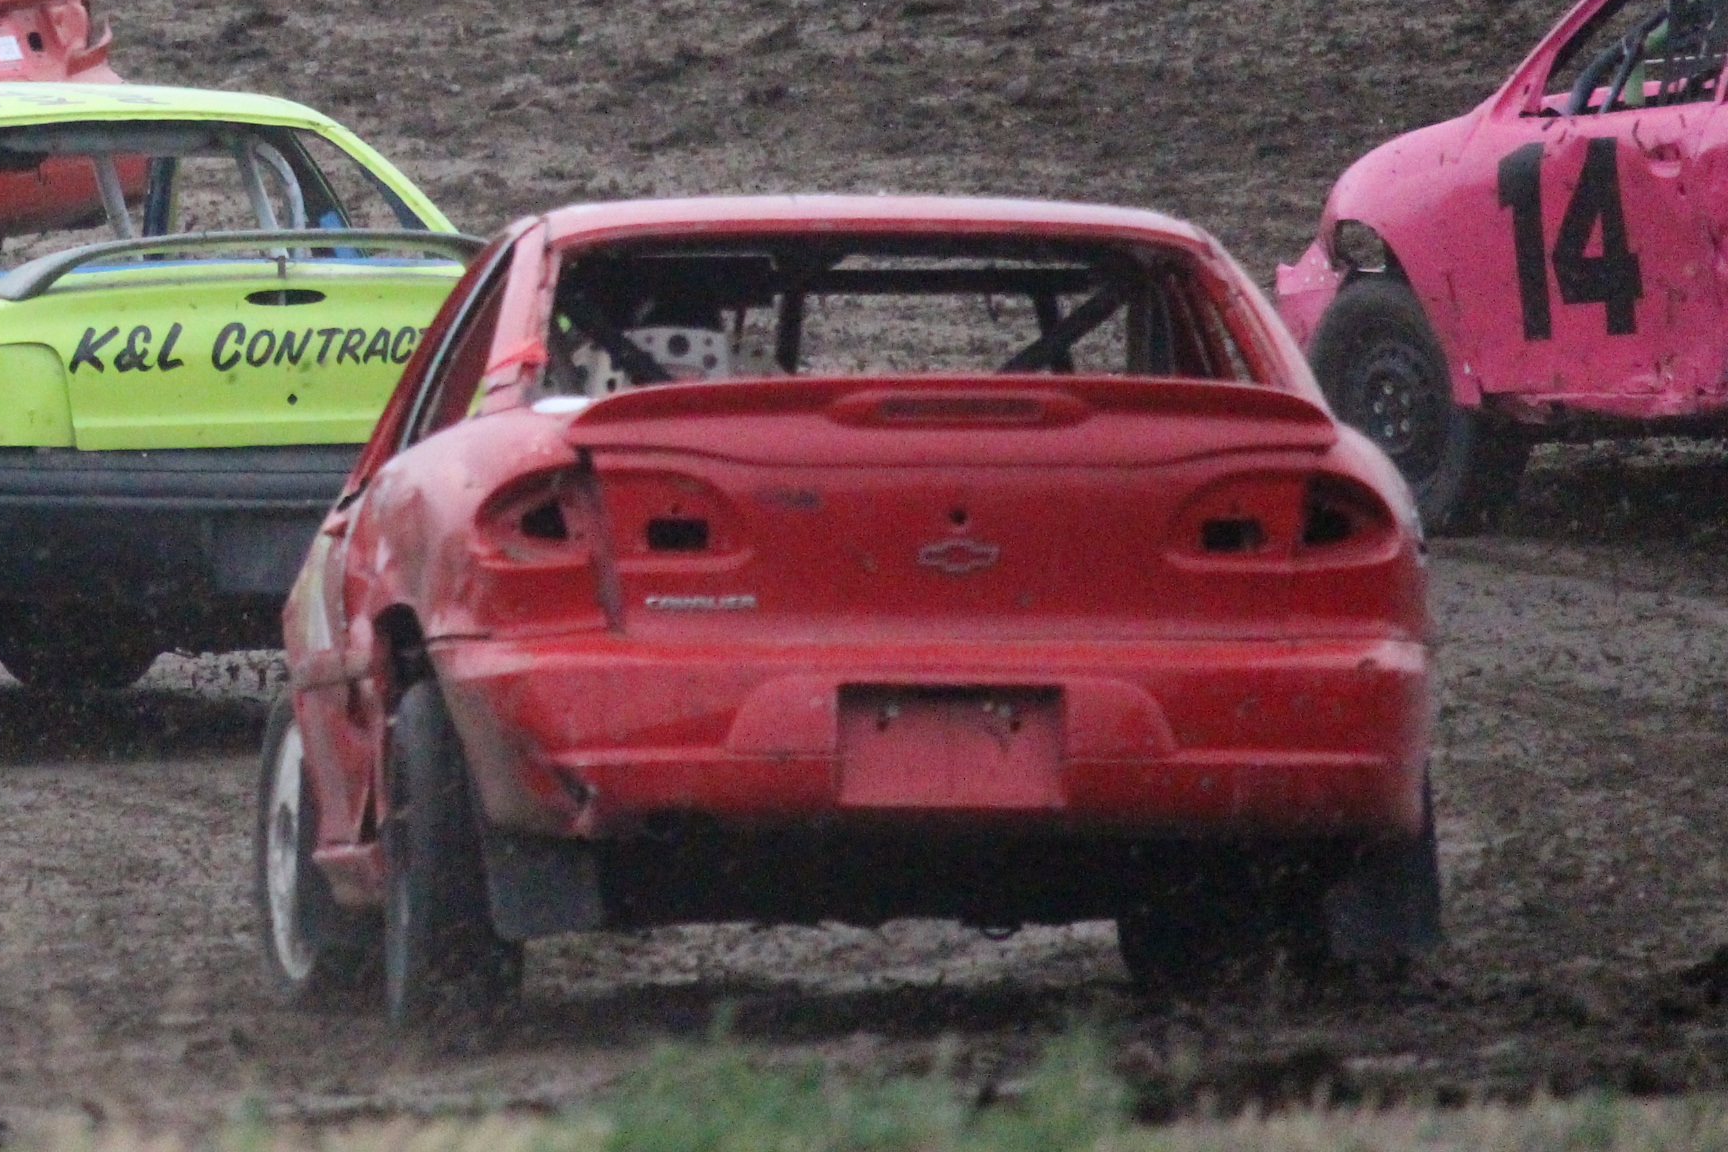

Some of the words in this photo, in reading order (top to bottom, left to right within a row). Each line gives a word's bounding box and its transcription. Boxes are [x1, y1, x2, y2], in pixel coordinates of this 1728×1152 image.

[1497, 136, 1644, 341] 14
[68, 322, 185, 374] K&L
[211, 322, 430, 372] CONTRAC
